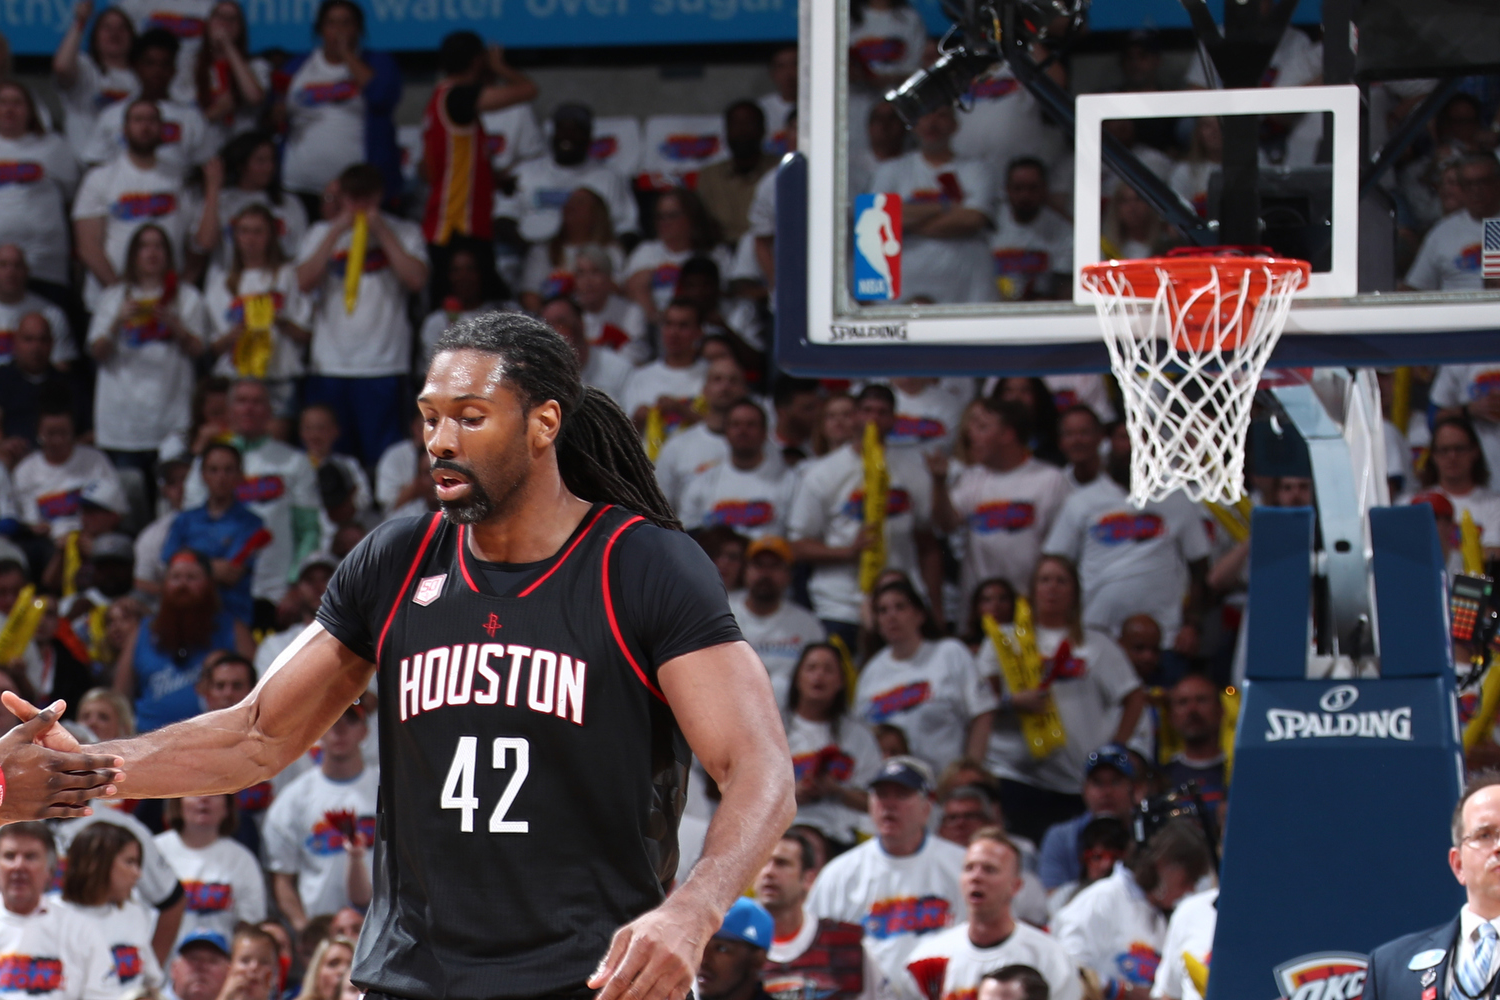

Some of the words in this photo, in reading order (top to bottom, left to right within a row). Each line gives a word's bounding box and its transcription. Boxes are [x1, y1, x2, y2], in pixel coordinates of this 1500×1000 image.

[858, 278, 887, 295] NBA
[830, 322, 908, 341] SPALDING
[399, 643, 587, 726] HOUSTON
[1265, 706, 1412, 742] SPALDING
[440, 736, 530, 833] 42
